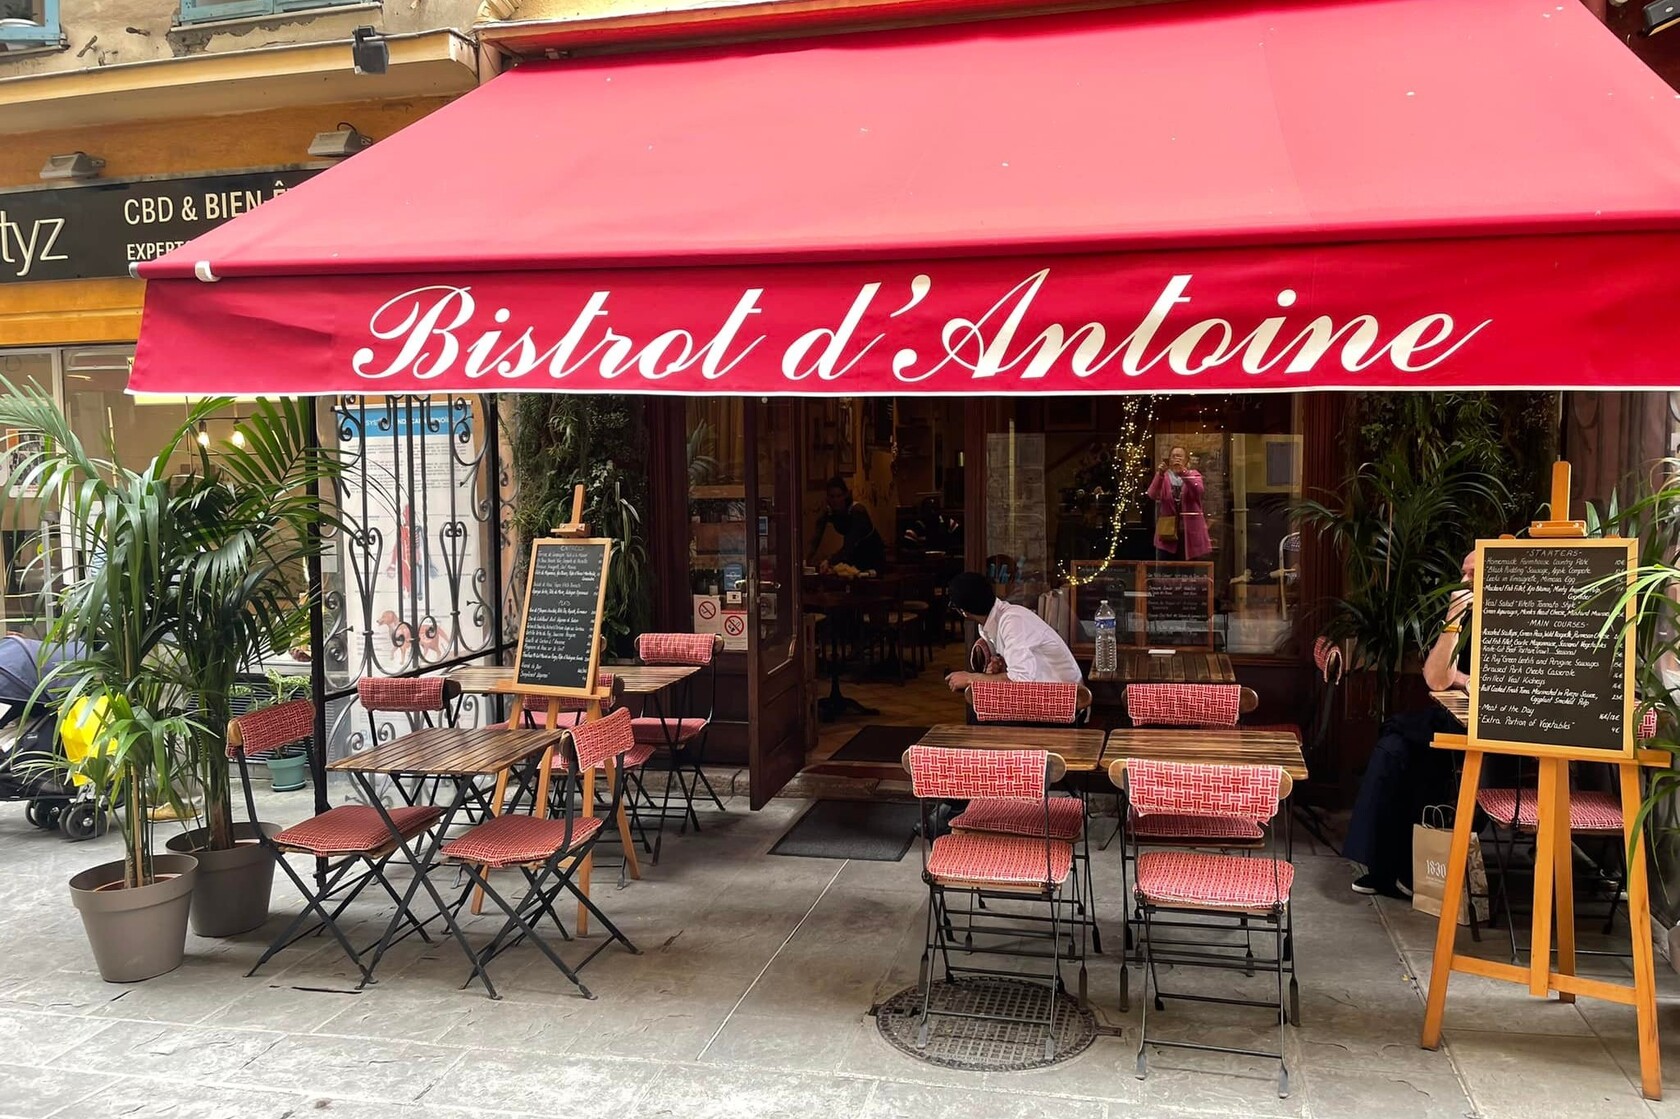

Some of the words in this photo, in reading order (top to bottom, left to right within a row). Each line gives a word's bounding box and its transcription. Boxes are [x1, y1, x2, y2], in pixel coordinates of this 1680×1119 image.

[124, 196, 174, 225] CBD
[181, 195, 198, 222] &
[352, 284, 767, 380] Bistrot
[1564, 575, 1576, 586] Egg
[1498, 599, 1515, 607] Salad
[1502, 655, 1518, 664] Green
[1535, 657, 1549, 666] and
[1508, 664, 1523, 674] Pork
[1481, 674, 1505, 683] Grilled
[1499, 704, 1508, 712] of
[1508, 705, 1520, 713] the
[1520, 706, 1536, 717] Day
[1504, 715, 1527, 727] Portion
[1528, 718, 1538, 727] of
